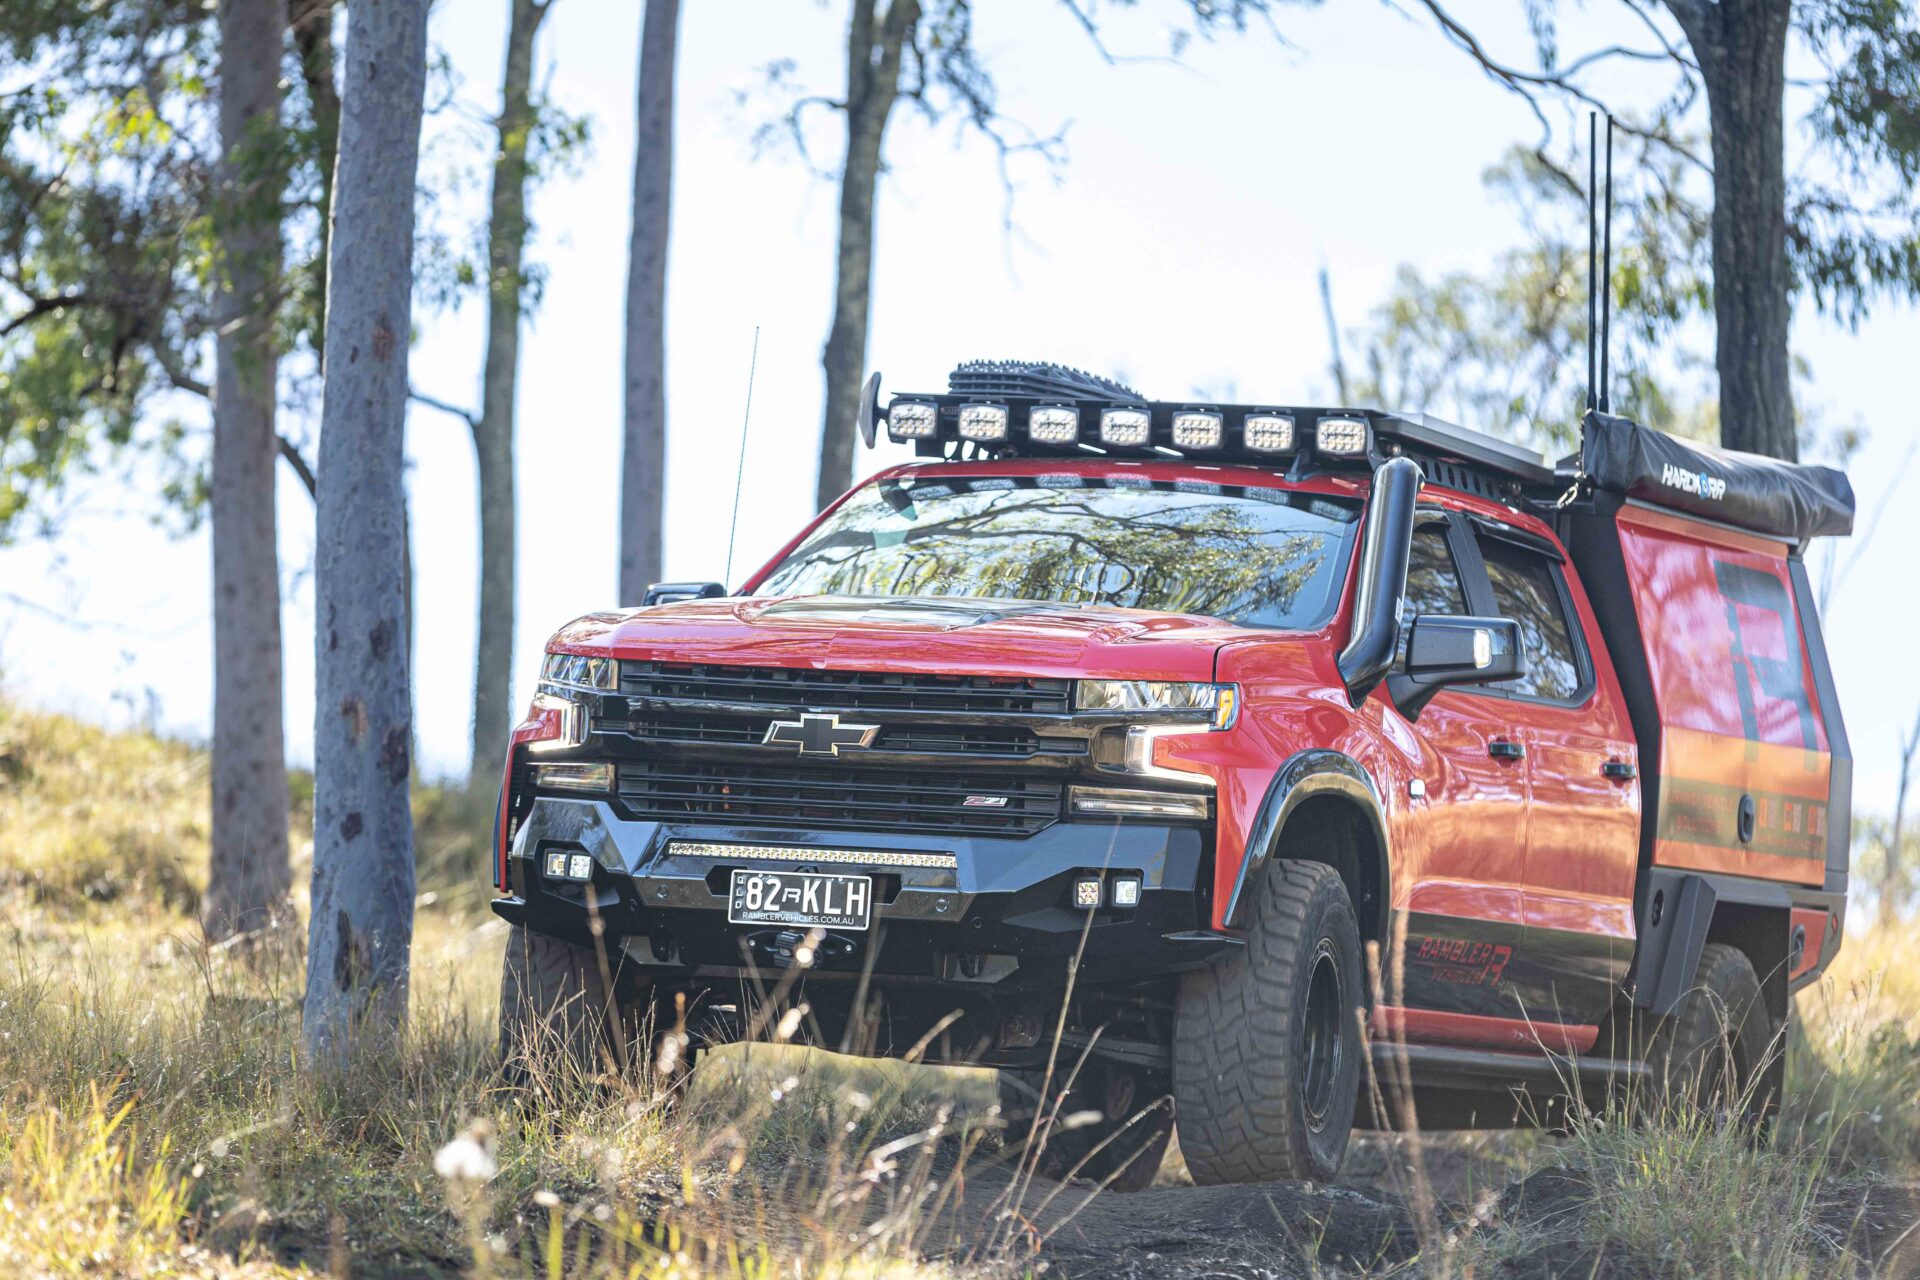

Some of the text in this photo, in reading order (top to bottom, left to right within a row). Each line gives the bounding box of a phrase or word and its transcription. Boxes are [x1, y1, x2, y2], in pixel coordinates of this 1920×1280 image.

[801, 878, 866, 917] KLH
[742, 911, 855, 926] RAMBLERVEHICLES.COM.AU
[1417, 937, 1492, 963] RAMBLER
